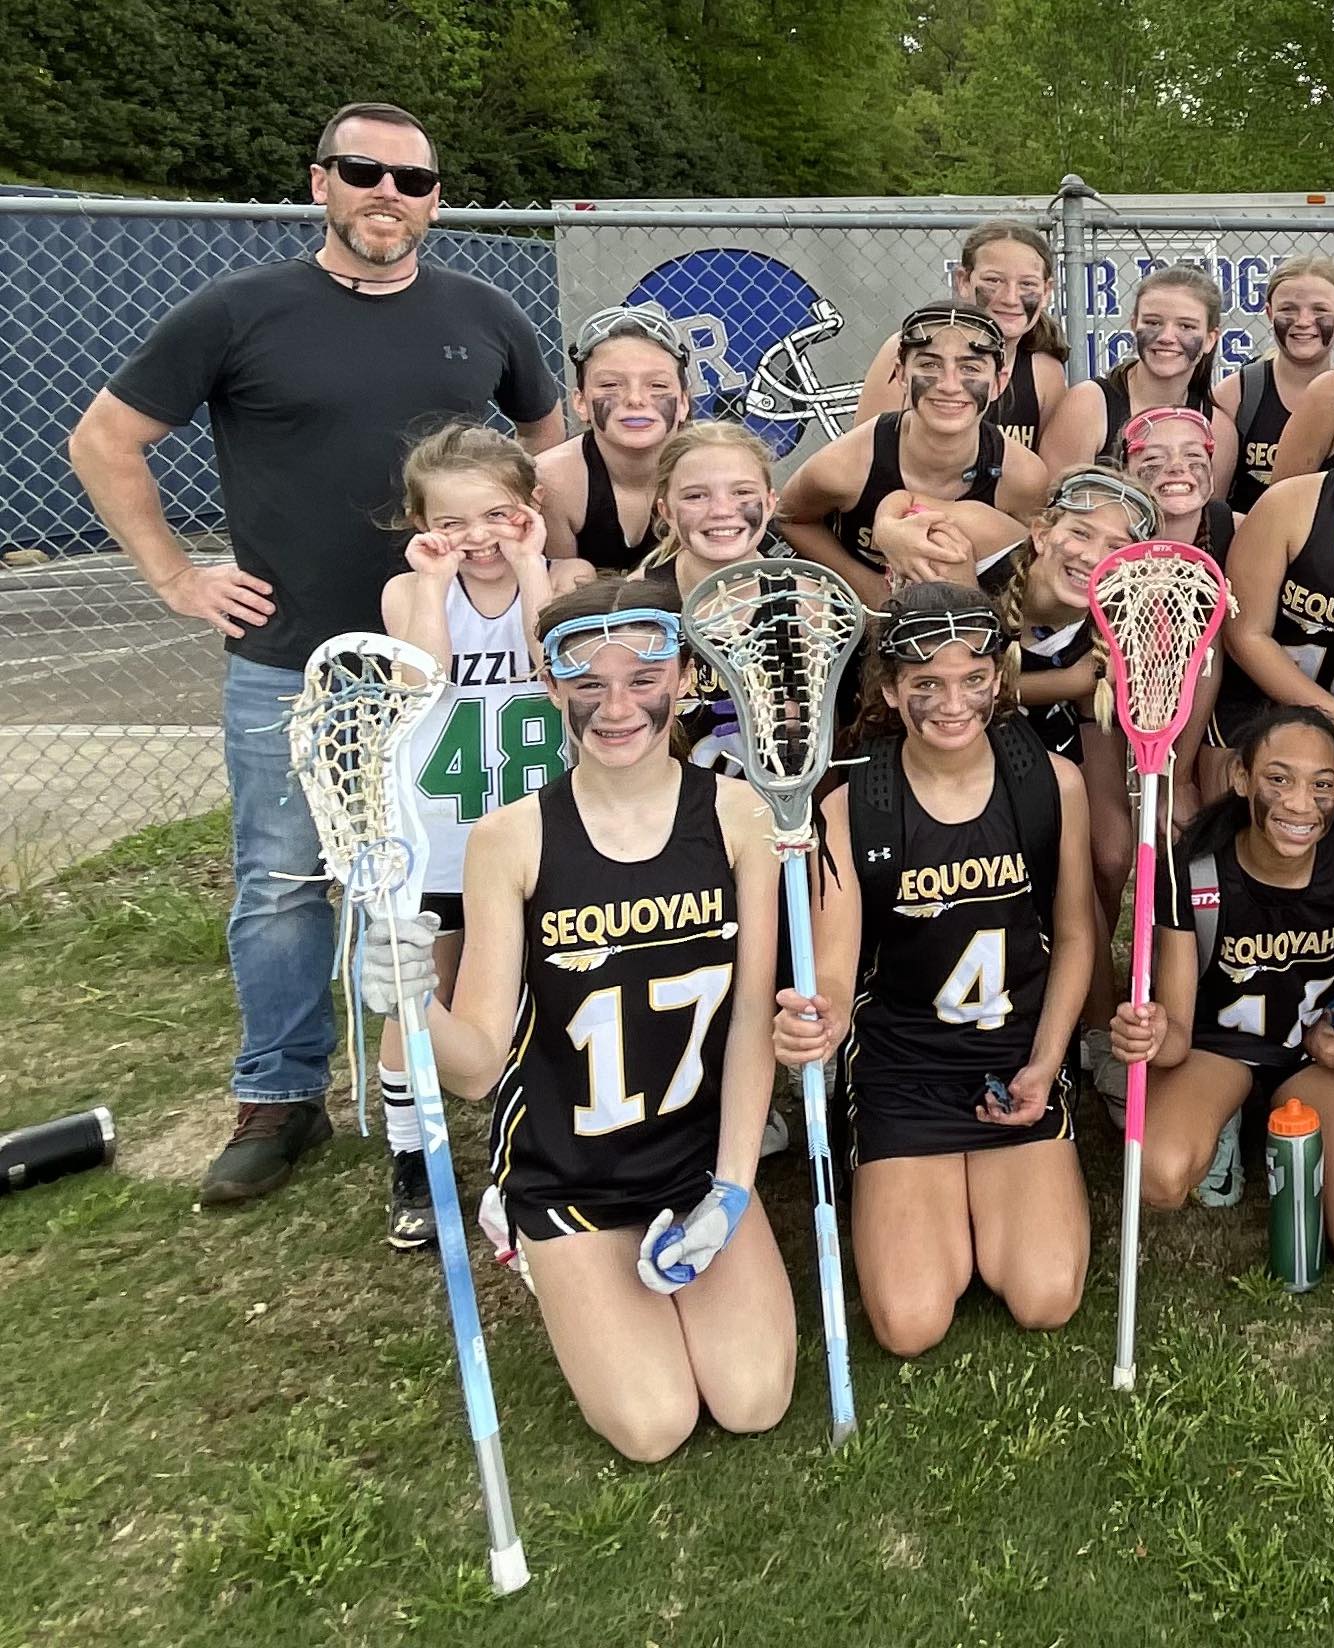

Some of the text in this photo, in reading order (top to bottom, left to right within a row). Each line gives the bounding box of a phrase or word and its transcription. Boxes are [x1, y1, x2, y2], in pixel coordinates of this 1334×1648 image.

[450, 651, 538, 686] IZZL
[416, 693, 567, 824] 48
[897, 853, 1030, 901] EQUOYA
[1191, 891, 1221, 905] STX
[541, 888, 724, 947] SEQUOYAH
[932, 928, 1014, 1031] 4
[565, 962, 734, 1137] 17
